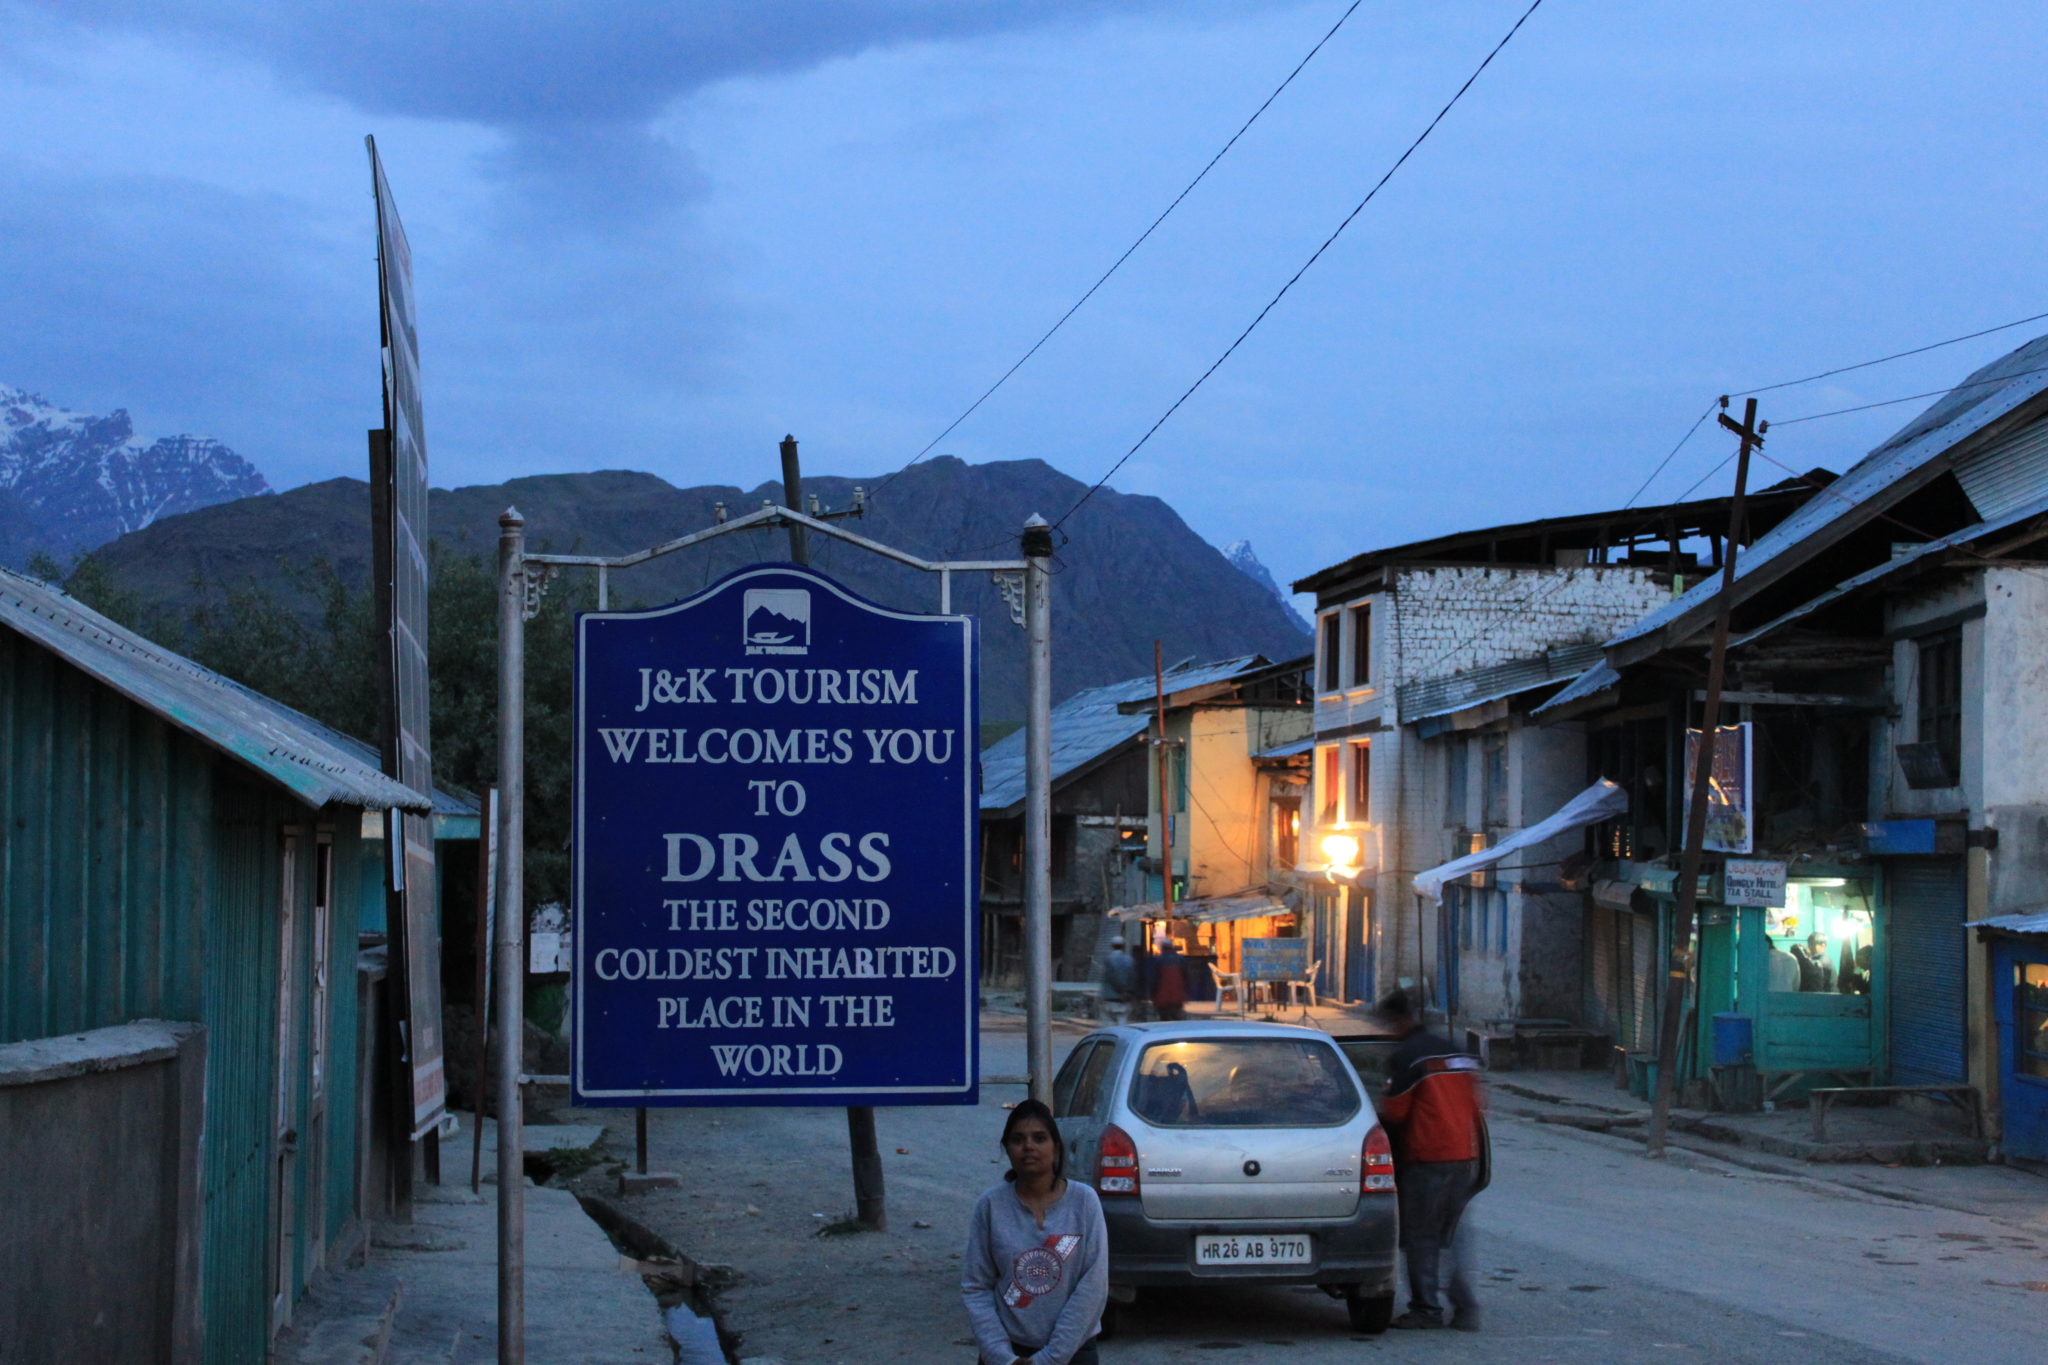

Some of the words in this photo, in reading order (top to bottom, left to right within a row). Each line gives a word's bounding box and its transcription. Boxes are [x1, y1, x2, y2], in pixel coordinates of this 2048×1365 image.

[635, 668, 717, 712] J&K
[725, 668, 919, 704] TOURISM
[598, 728, 853, 764] WELCOMES
[863, 728, 955, 764] YOU
[748, 780, 807, 816] TO
[661, 832, 892, 882] DRASS
[663, 899, 739, 931] THE
[746, 899, 891, 931] SECOND
[595, 948, 758, 981] COLDEST
[765, 946, 957, 979] INHABITED
[657, 997, 764, 1029] PLACE
[771, 997, 811, 1028] IN
[820, 996, 896, 1027] THE
[710, 1044, 843, 1077] WORLD
[1245, 1243, 1264, 1257] AB
[1270, 1242, 1304, 1257] 9770
